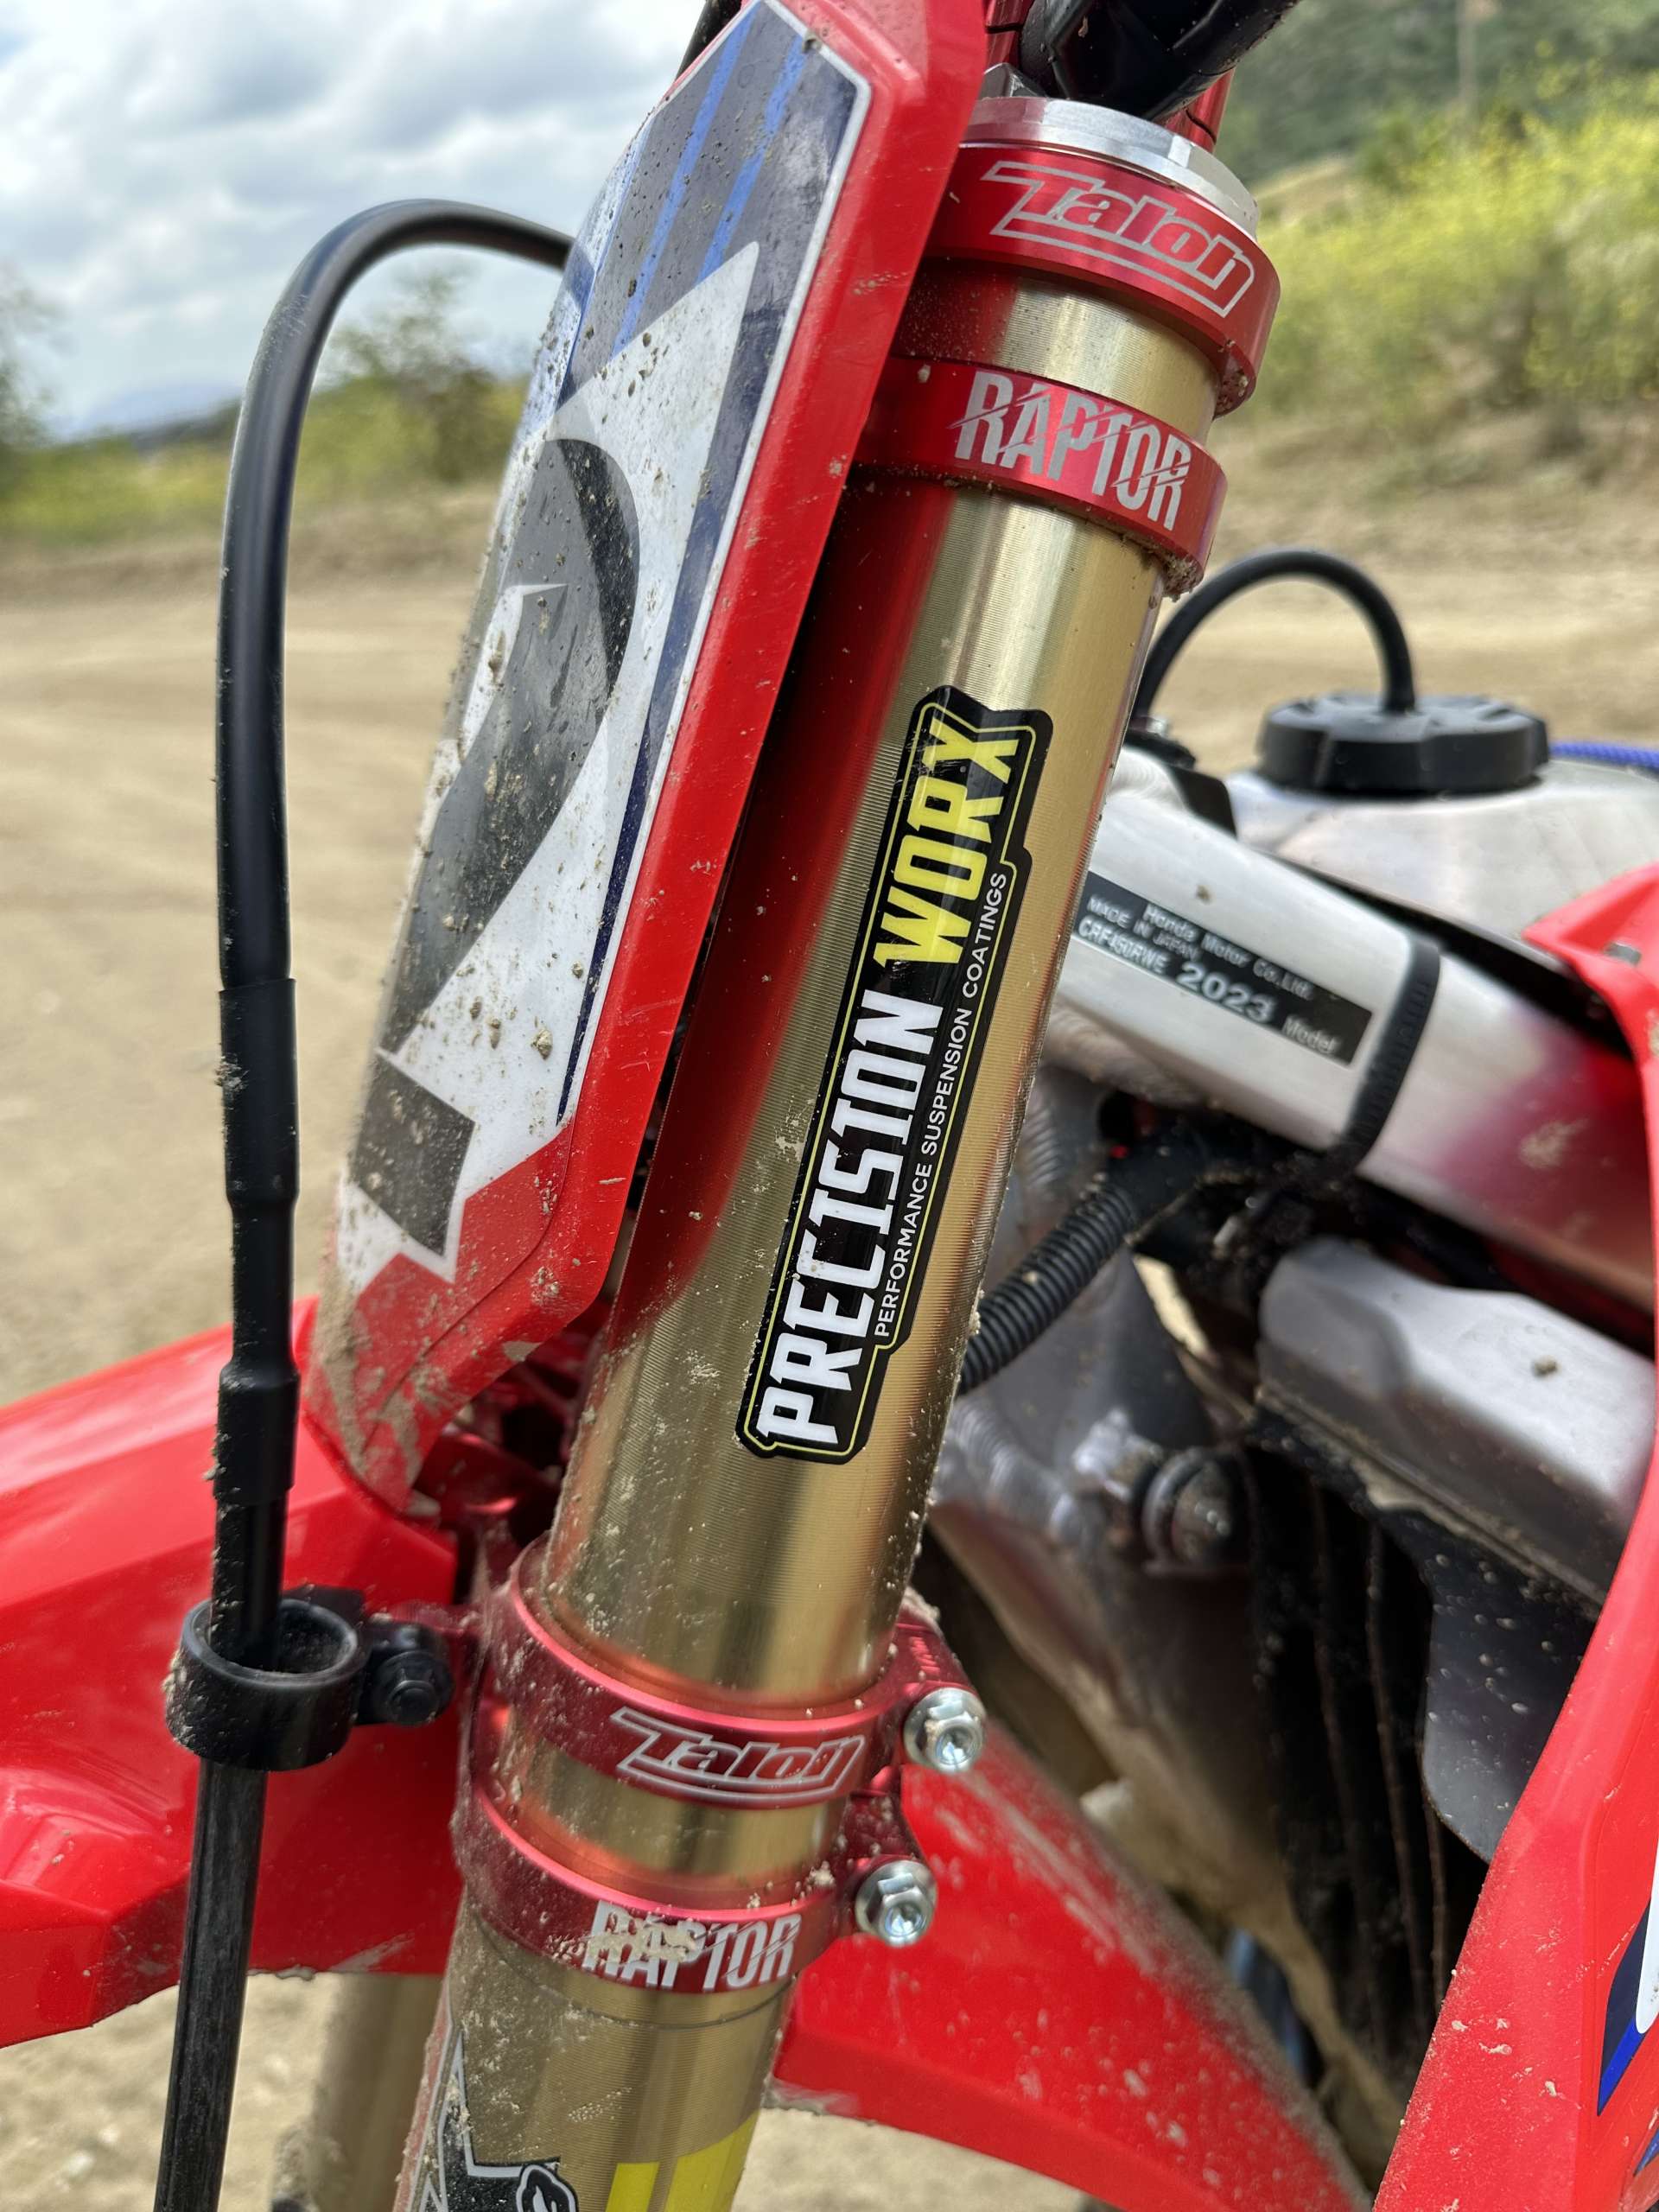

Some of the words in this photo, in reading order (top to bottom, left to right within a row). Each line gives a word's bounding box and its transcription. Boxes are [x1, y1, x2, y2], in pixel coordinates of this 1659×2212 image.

[981, 161, 1255, 318] Talon
[947, 370, 1192, 531] RAPTOR
[1086, 896, 1131, 928] MADE
[1133, 919, 1154, 937] IN
[1152, 930, 1202, 961] JAPAN
[1142, 904, 1198, 942] Honda
[1202, 932, 1252, 968] Motor
[1176, 962, 1278, 1023] 2023
[1281, 1014, 1338, 1054] Model
[757, 988, 944, 1445] PRECISION
[874, 718, 1020, 971] WORX
[874, 1160, 931, 1337] PERFORMANCE
[921, 1025, 970, 1155] SUSPENSION
[962, 872, 1007, 999] COATINGS
[610, 1707, 865, 1803] Talon
[582, 1900, 802, 1991] RAPTOR
